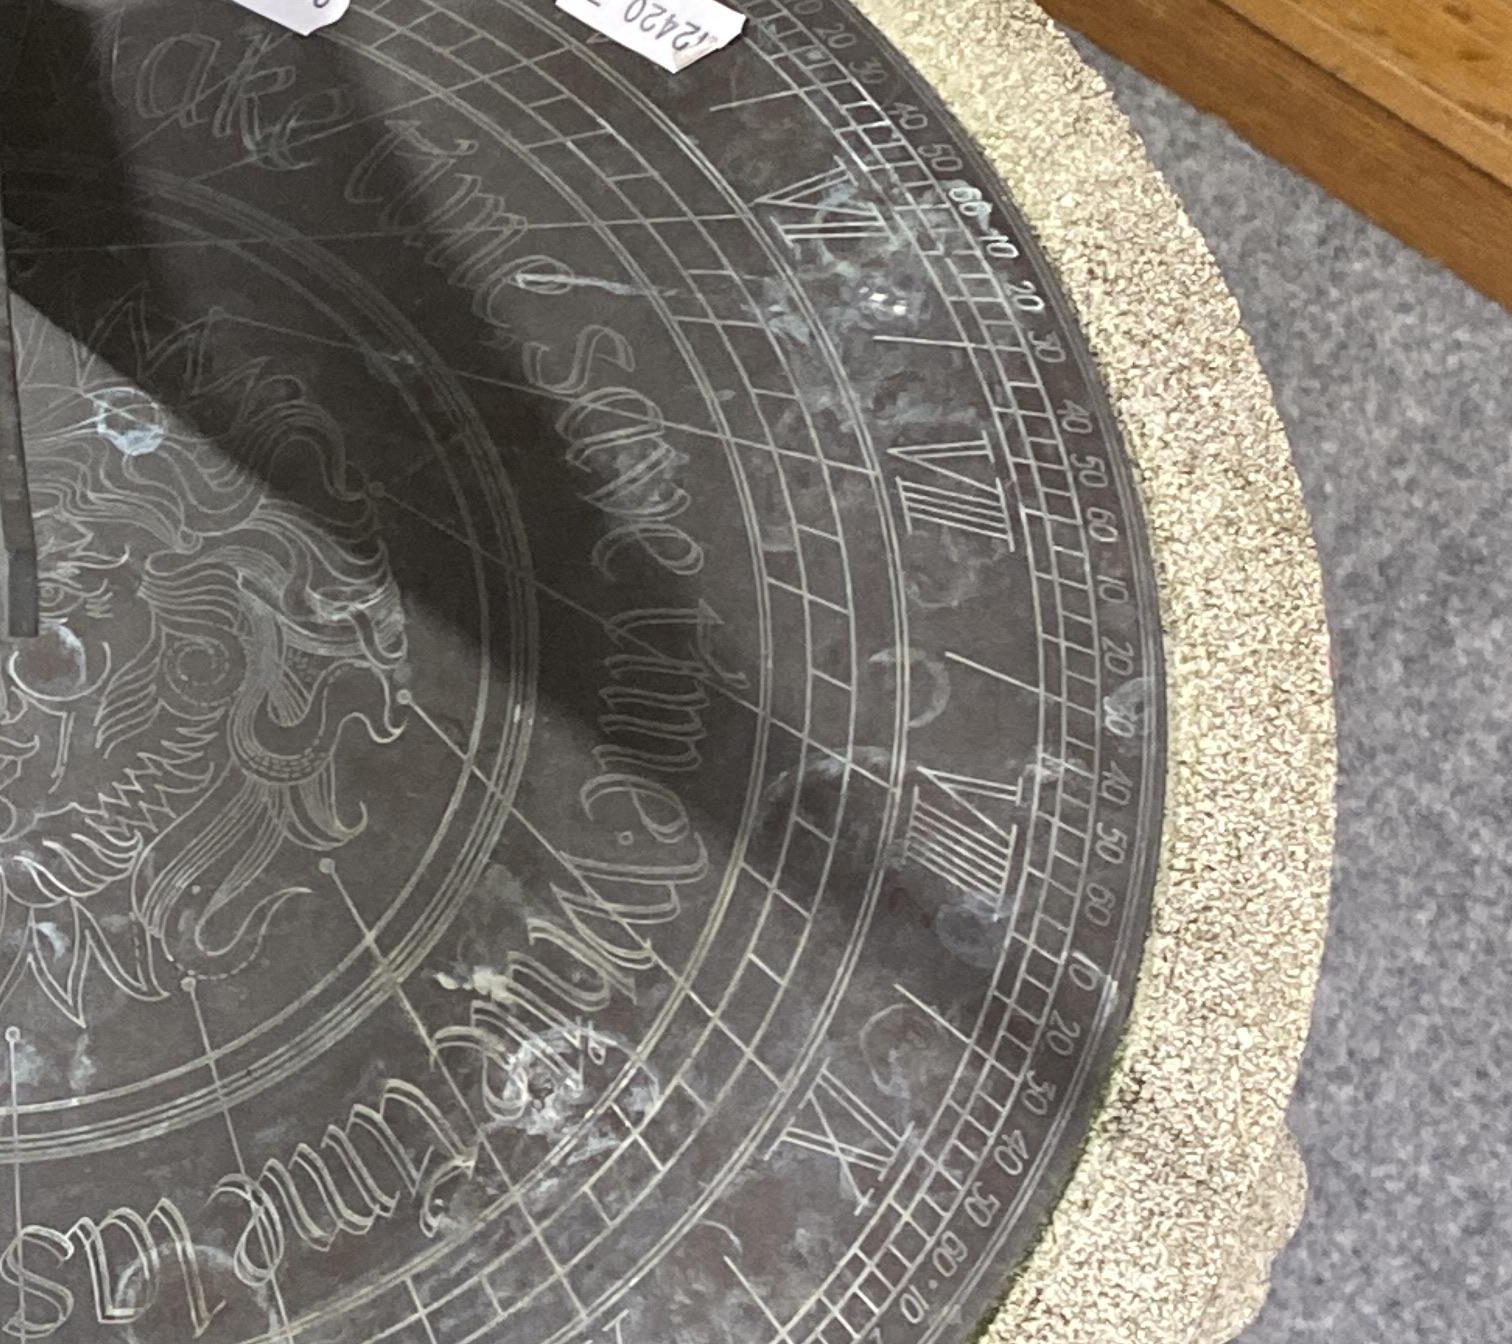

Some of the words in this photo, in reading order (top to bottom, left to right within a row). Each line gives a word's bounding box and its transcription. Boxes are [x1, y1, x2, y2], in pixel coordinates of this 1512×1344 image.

[100, 6, 354, 171] ake
[815, 19, 856, 49] 20
[849, 56, 889, 83] 30
[887, 101, 927, 130] 40
[918, 141, 961, 172] 50
[949, 185, 991, 215] 60
[755, 155, 895, 248] VI
[981, 234, 1017, 258] 10
[1005, 284, 1044, 310] 20
[1026, 331, 1065, 360] 30
[1055, 402, 1092, 431] 40
[522, 321, 706, 577] save
[1070, 455, 1107, 485] 50
[1084, 509, 1118, 541] 60
[1096, 576, 1128, 601] 10
[1102, 638, 1133, 673] 20
[1102, 698, 1135, 735] 30
[1100, 762, 1132, 804] 40
[1093, 824, 1127, 862] 50
[1083, 884, 1115, 925] 60
[431, 836, 710, 1121] While
[1066, 952, 1100, 990] 10
[1044, 1012, 1080, 1055] 20
[1018, 1071, 1054, 1114] 30
[764, 1064, 914, 1216] IX
[993, 1127, 1031, 1174] 40
[214, 1078, 478, 1288] time
[961, 1182, 999, 1226] 50
[929, 1231, 967, 1276] 60
[897, 1286, 929, 1323] 10
